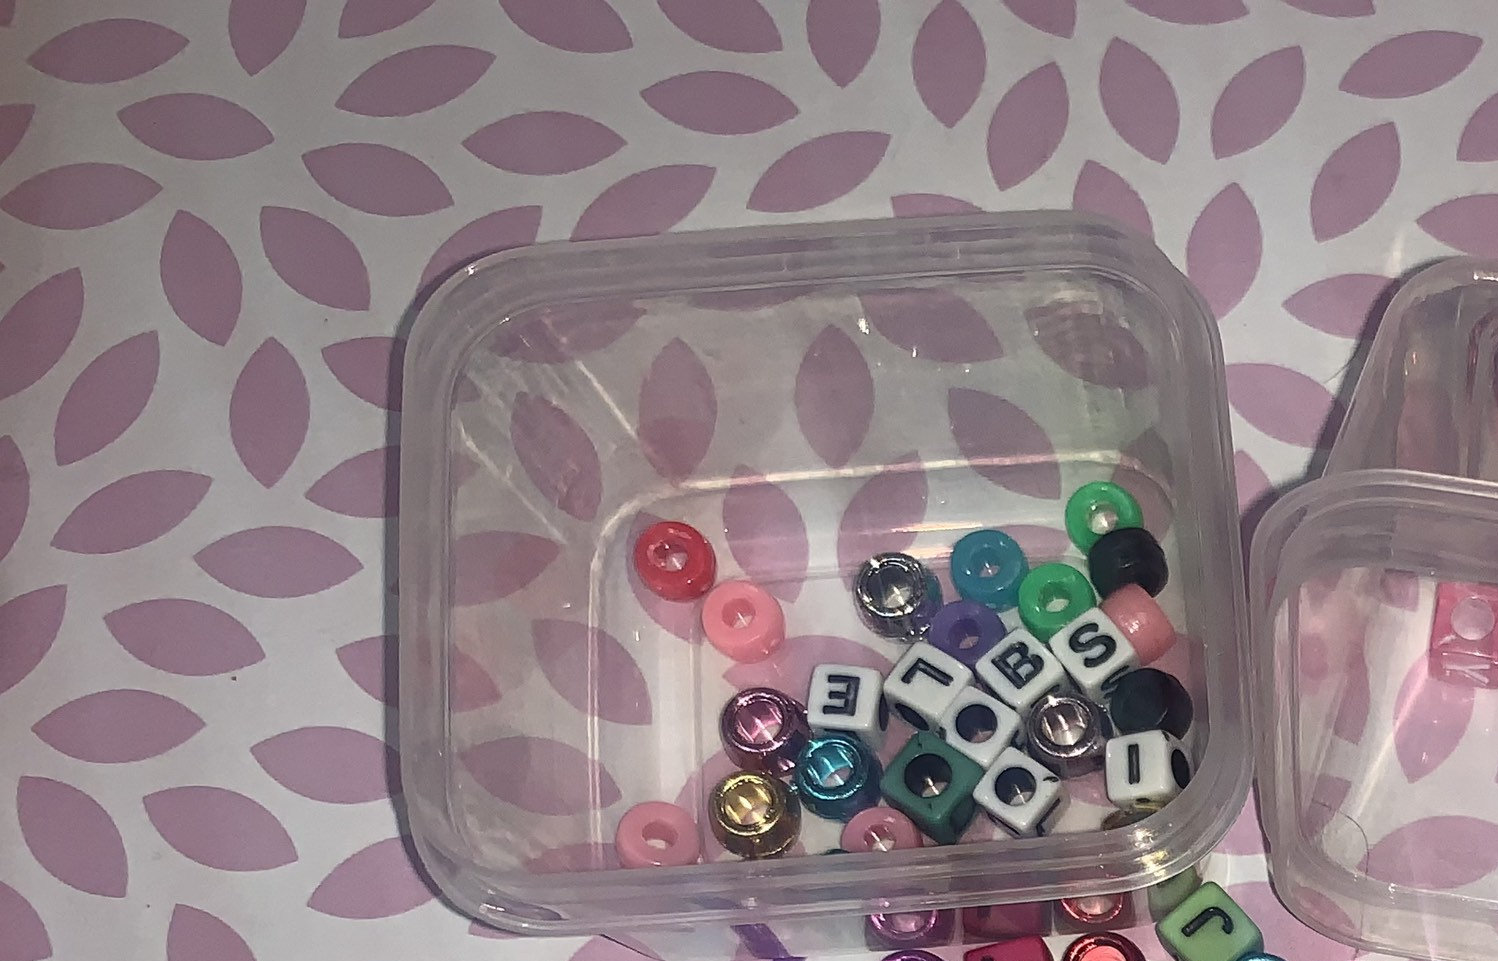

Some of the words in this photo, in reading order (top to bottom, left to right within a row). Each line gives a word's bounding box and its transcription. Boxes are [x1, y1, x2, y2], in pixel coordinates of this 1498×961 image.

[991, 641, 1044, 690] B
[1068, 622, 1117, 668] S
[822, 674, 860, 716] E
